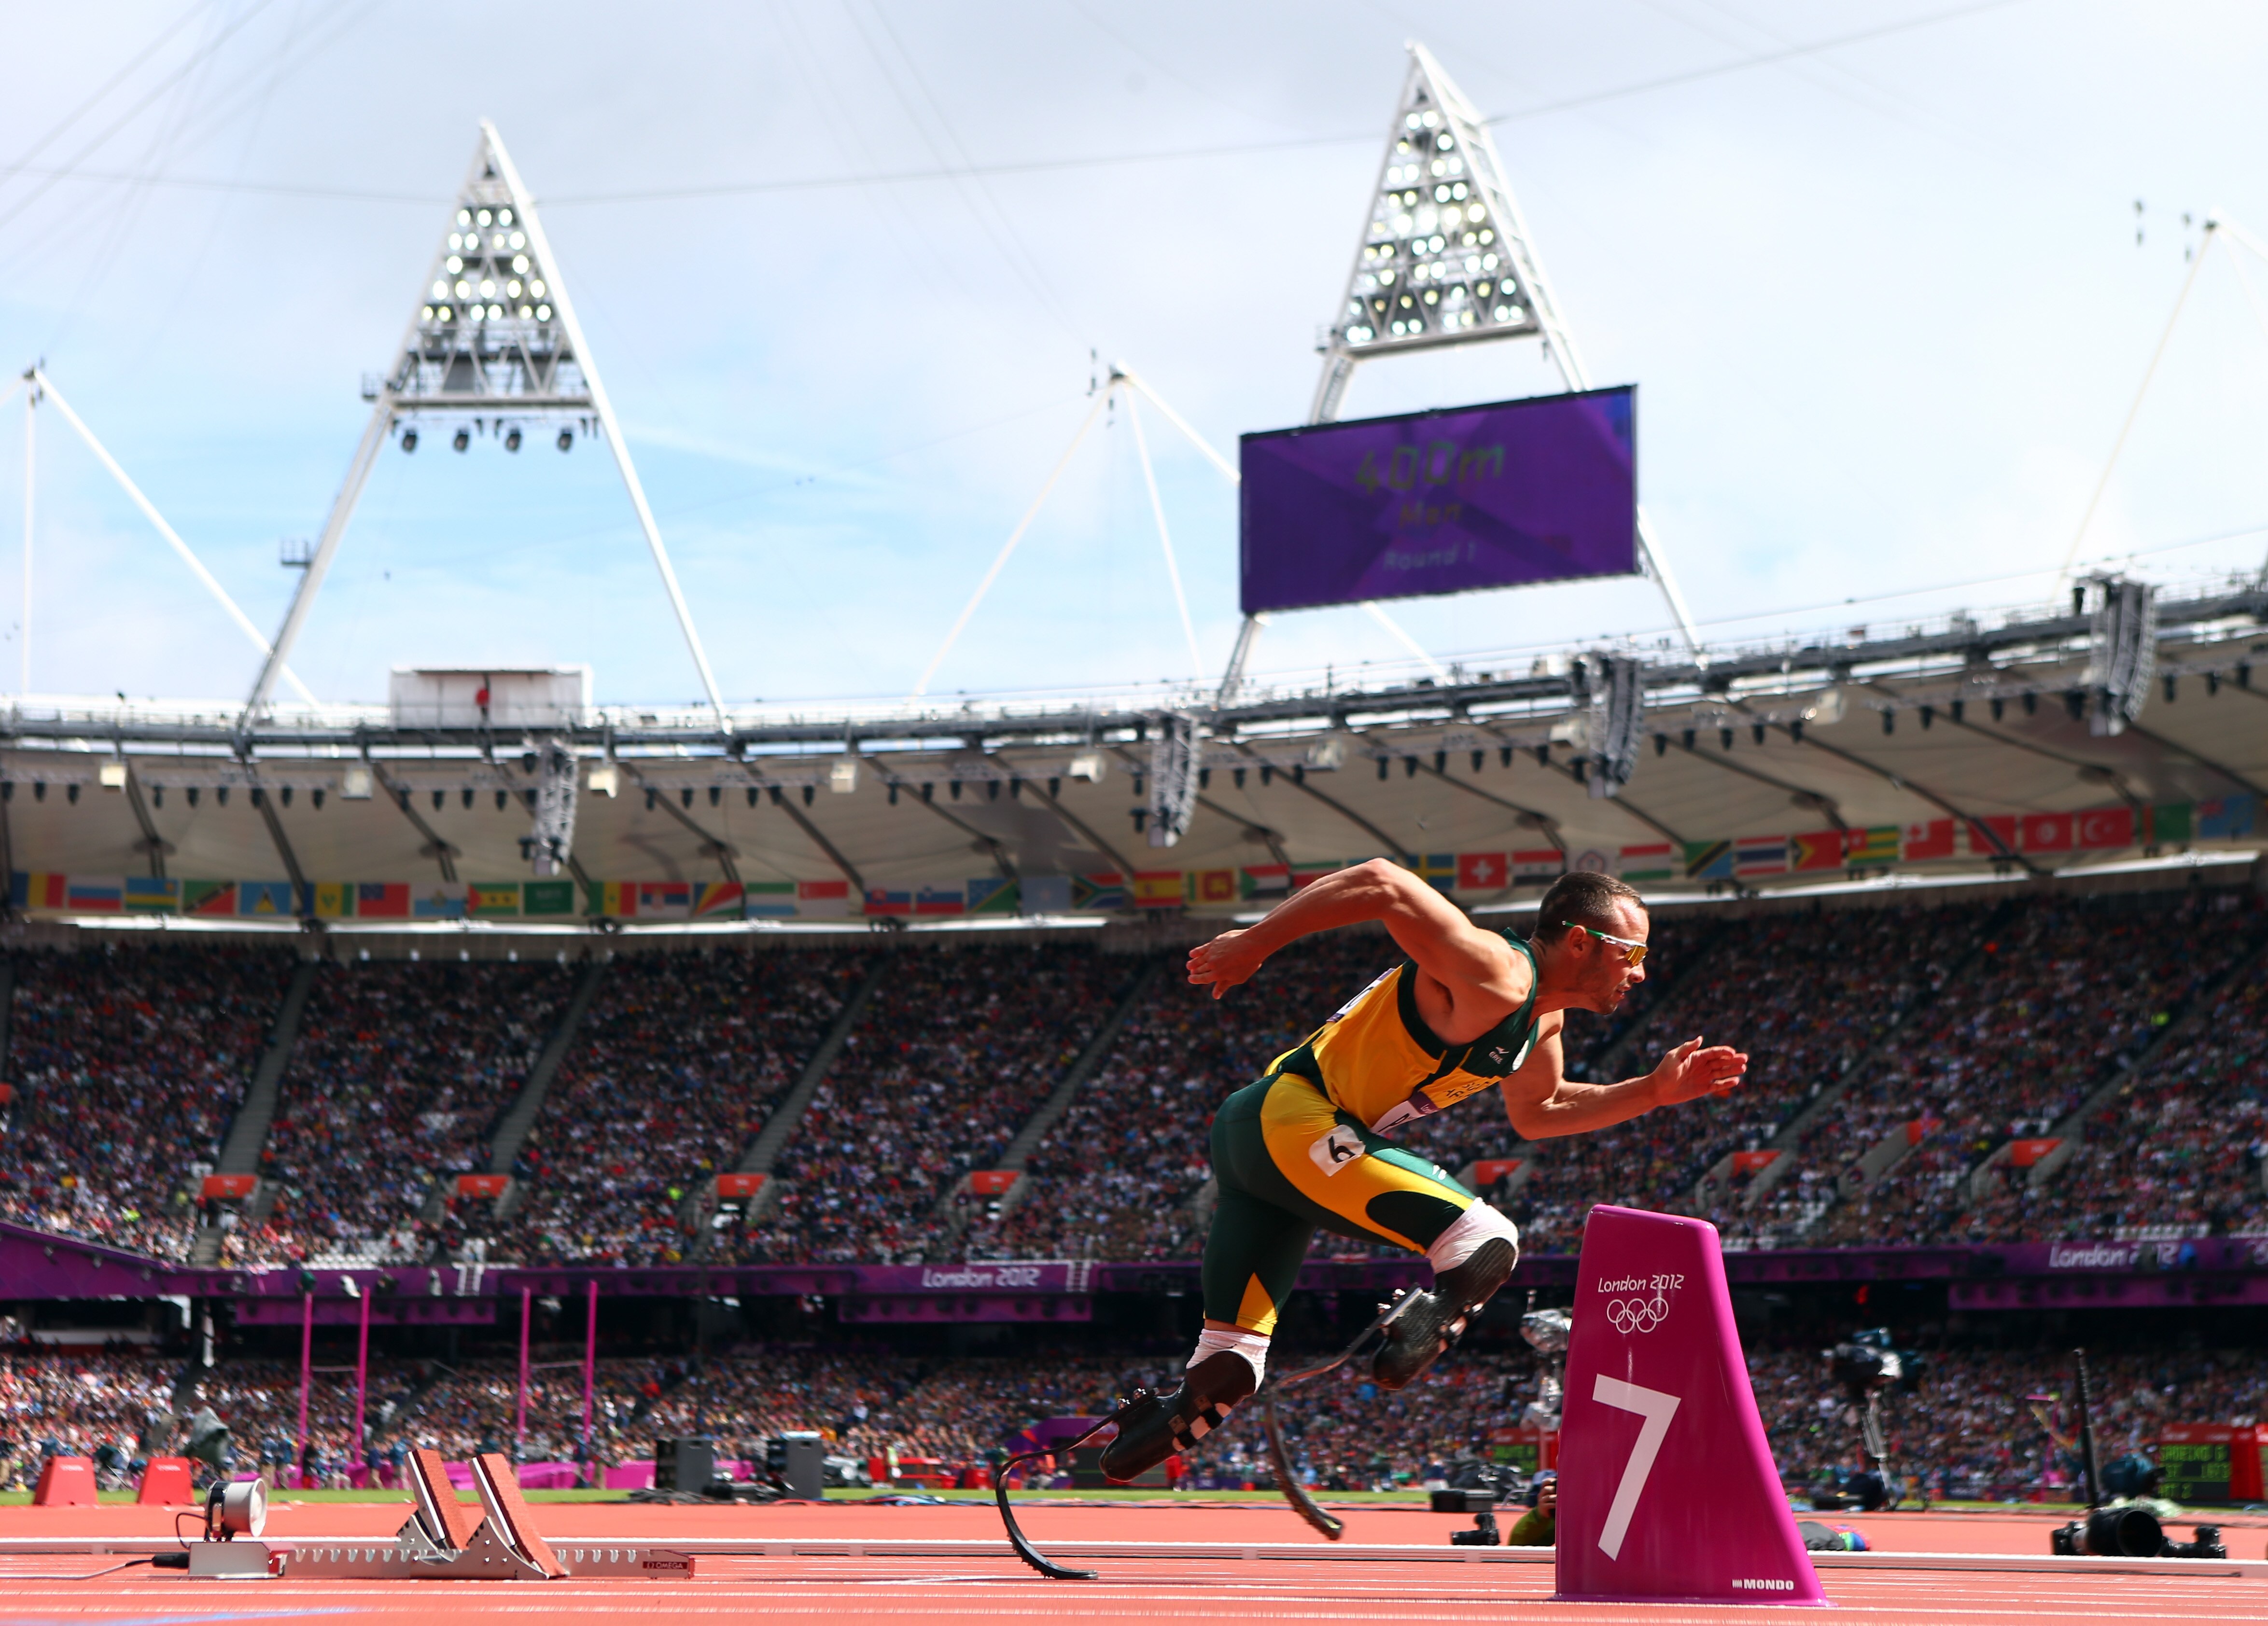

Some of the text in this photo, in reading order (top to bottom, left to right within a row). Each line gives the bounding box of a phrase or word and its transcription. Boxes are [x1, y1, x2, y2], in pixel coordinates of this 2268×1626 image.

[1356, 441, 1506, 495] 400m
[1398, 501, 1462, 529] Men
[1383, 540, 1477, 571] Round 1
[1328, 1135, 1356, 1164] 6
[2048, 1241, 2128, 1268] London
[922, 1266, 1041, 1288] London 2012
[1597, 1274, 1685, 1293] London 2012
[1592, 1373, 1681, 1562] 7
[1743, 1579, 1794, 1591] MONDO
